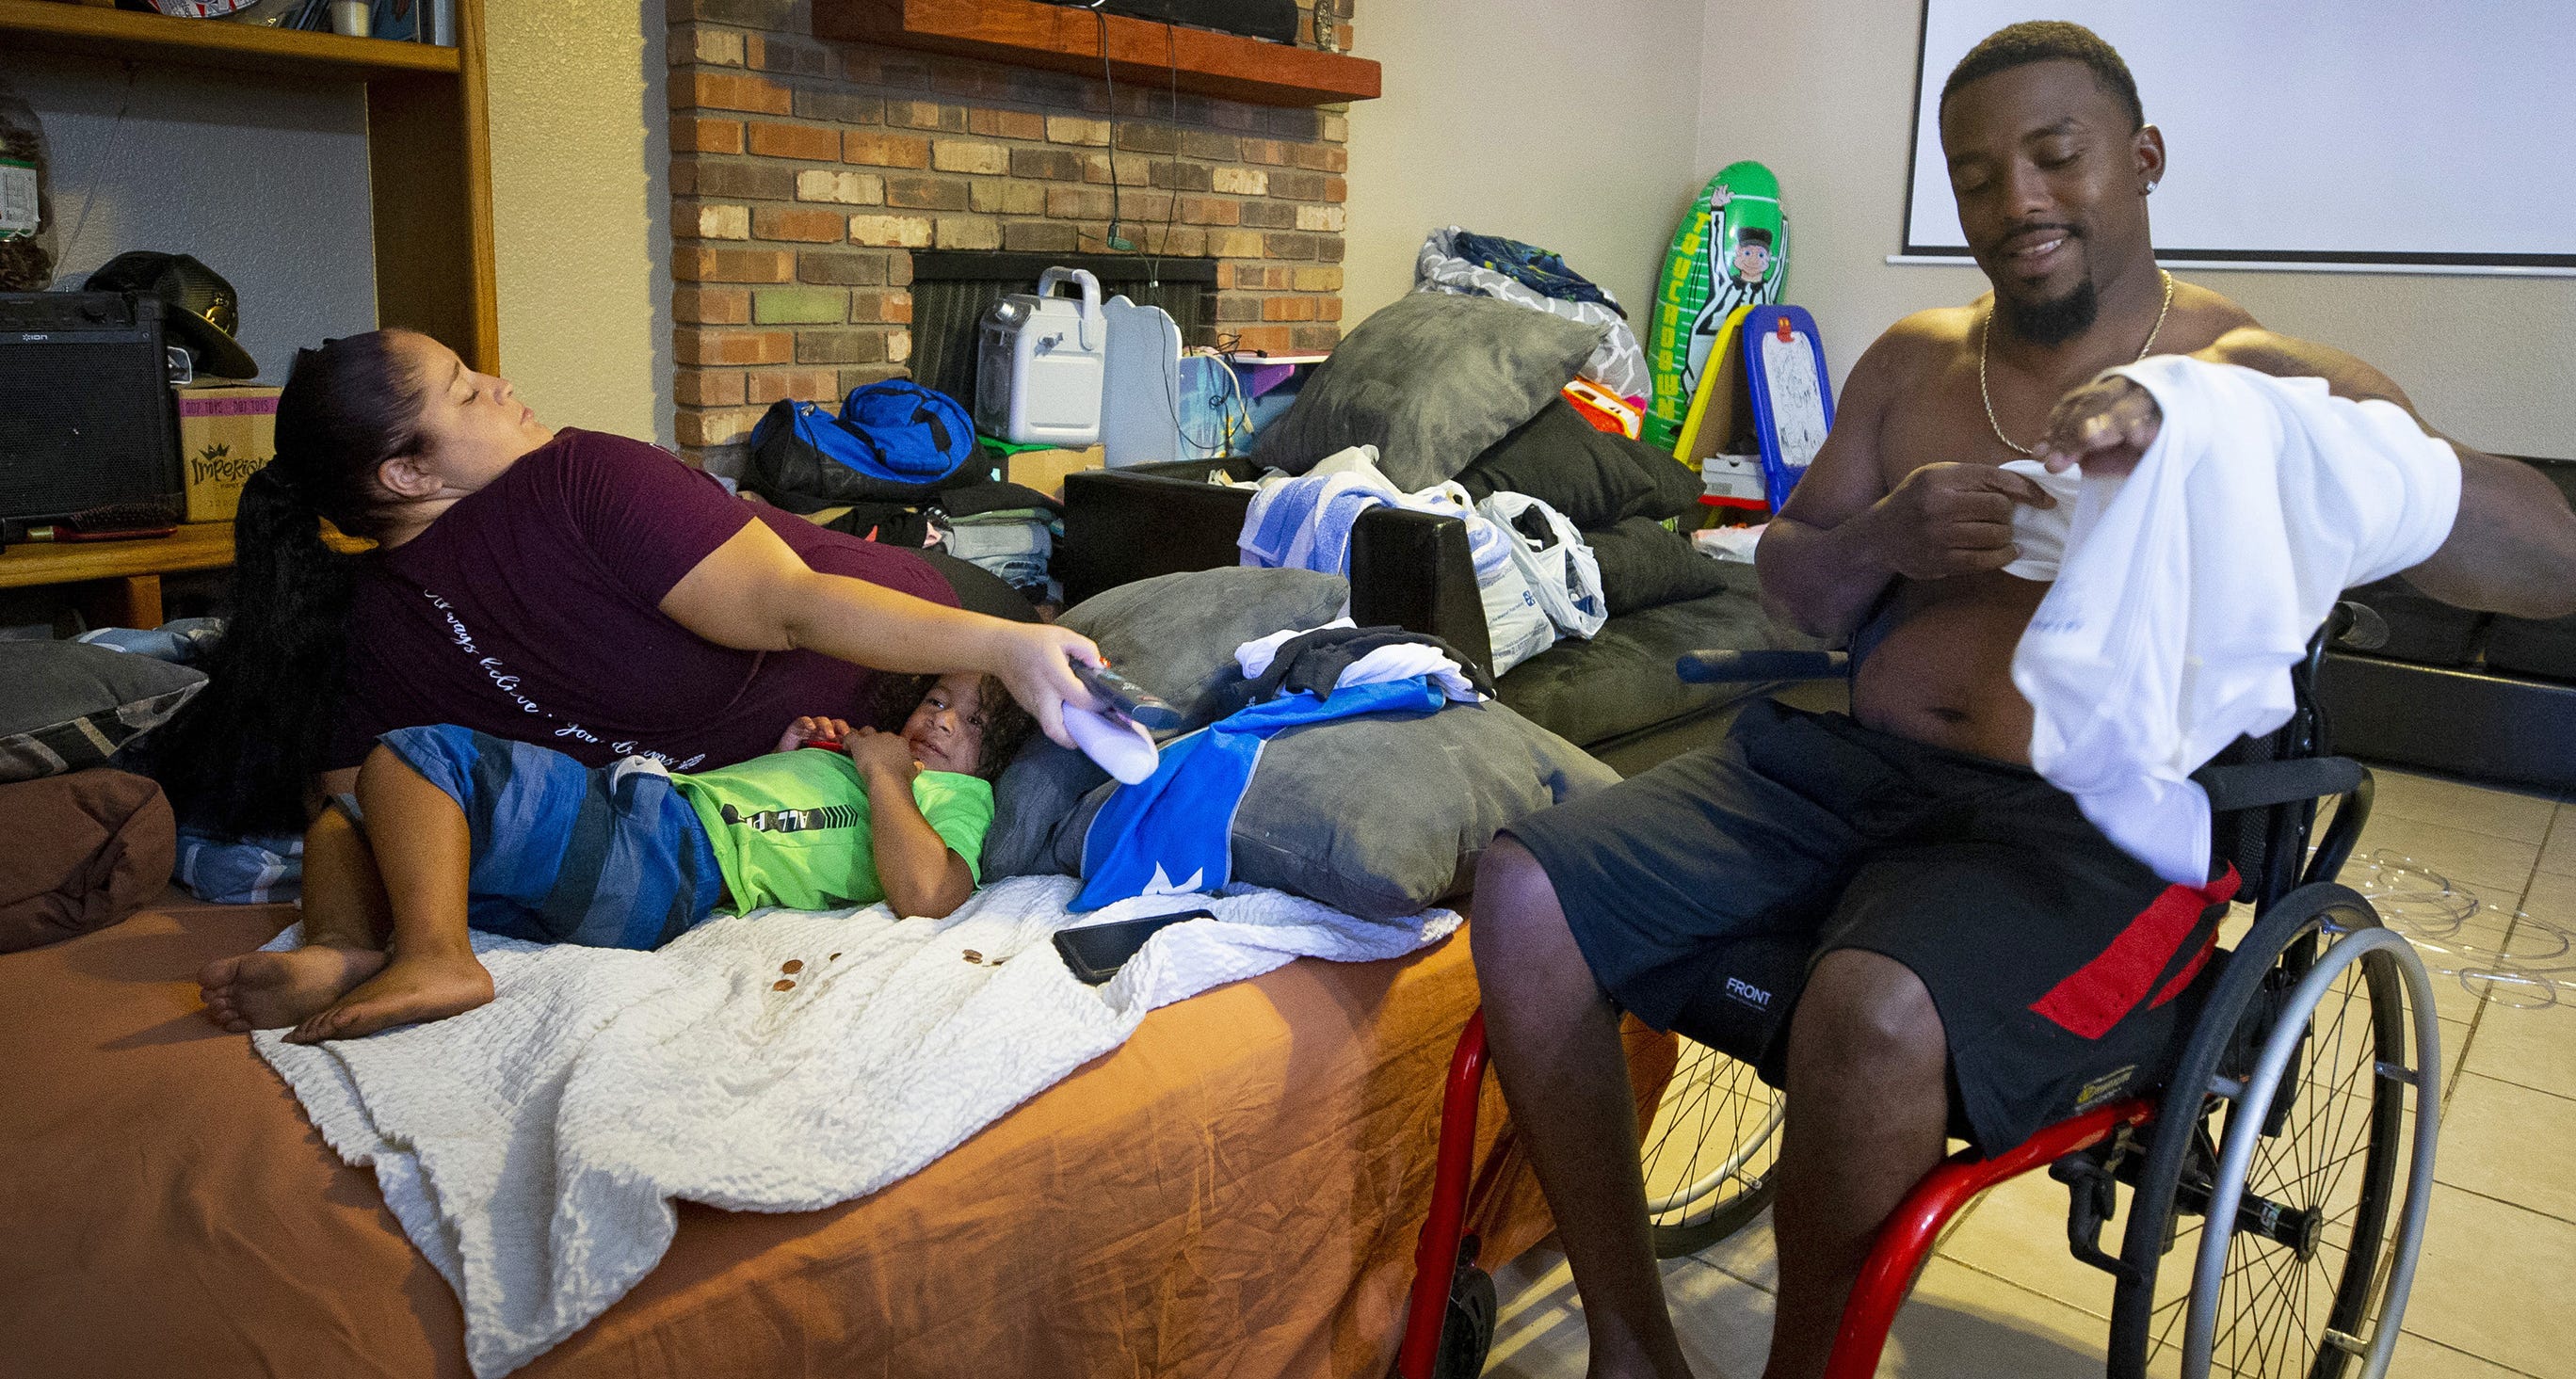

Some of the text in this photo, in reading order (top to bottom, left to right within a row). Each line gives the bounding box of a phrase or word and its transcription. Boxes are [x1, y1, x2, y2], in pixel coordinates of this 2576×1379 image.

[1656, 211, 1712, 421] TOUCHDOWN
[777, 810, 811, 832] ALL
[1727, 977, 1771, 1005] FRONT
